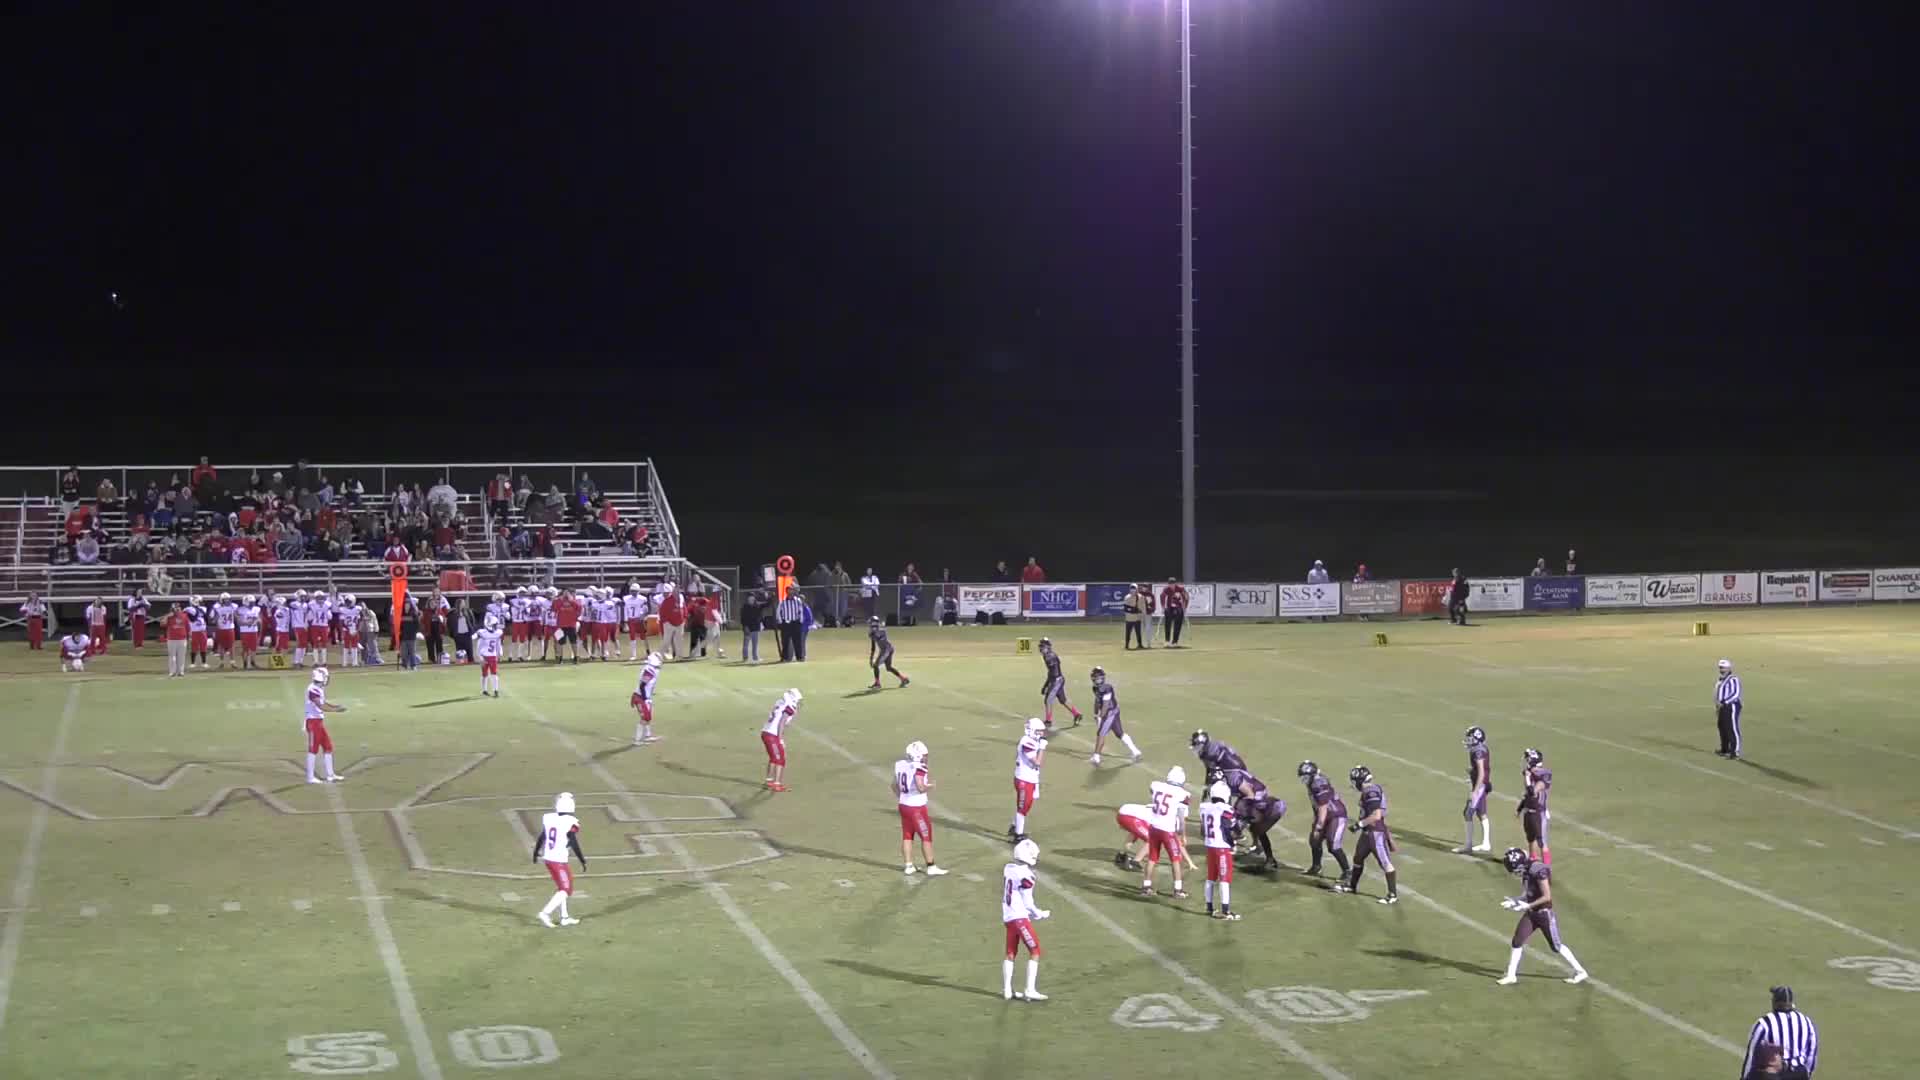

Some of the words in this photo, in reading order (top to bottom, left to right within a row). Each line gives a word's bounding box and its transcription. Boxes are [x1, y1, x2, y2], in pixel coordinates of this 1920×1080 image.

[1766, 574, 1811, 586] Republic
[963, 589, 1017, 599] PEPPERS
[1040, 590, 1070, 602] NHC
[1281, 586, 1312, 601] S&S
[1647, 580, 1696, 598] Watson
[487, 640, 496, 652] 5
[1151, 791, 1173, 816] 55
[1202, 812, 1216, 839] 12
[547, 826, 558, 850] 9
